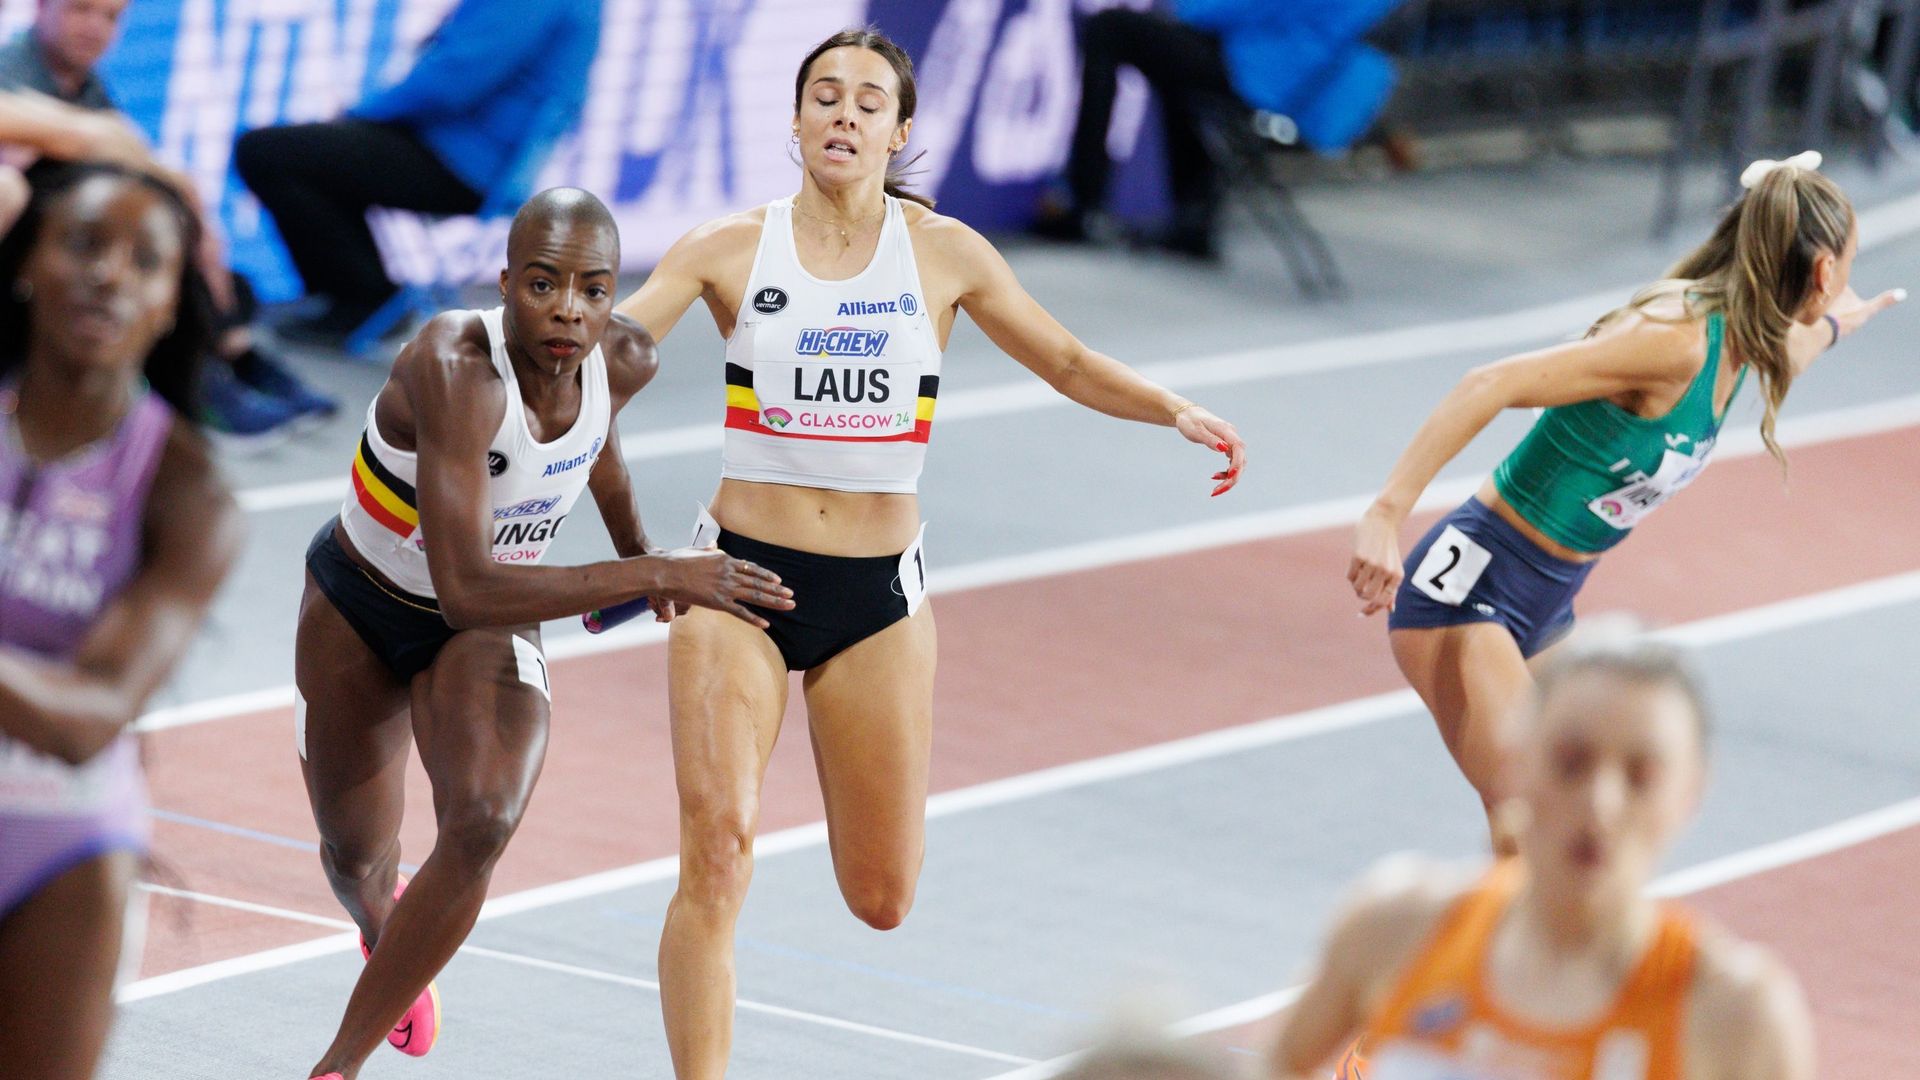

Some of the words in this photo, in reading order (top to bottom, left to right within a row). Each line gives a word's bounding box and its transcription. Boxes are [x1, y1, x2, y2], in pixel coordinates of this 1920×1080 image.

[837, 300, 898, 316] Allianz
[797, 329, 888, 357] HI-CHEW
[794, 367, 890, 403] LAUS
[799, 412, 893, 428] GLASGOW
[895, 412, 909, 426] 24
[542, 452, 588, 478] Allianz
[913, 547, 924, 592] 1
[1429, 545, 1461, 591] 2
